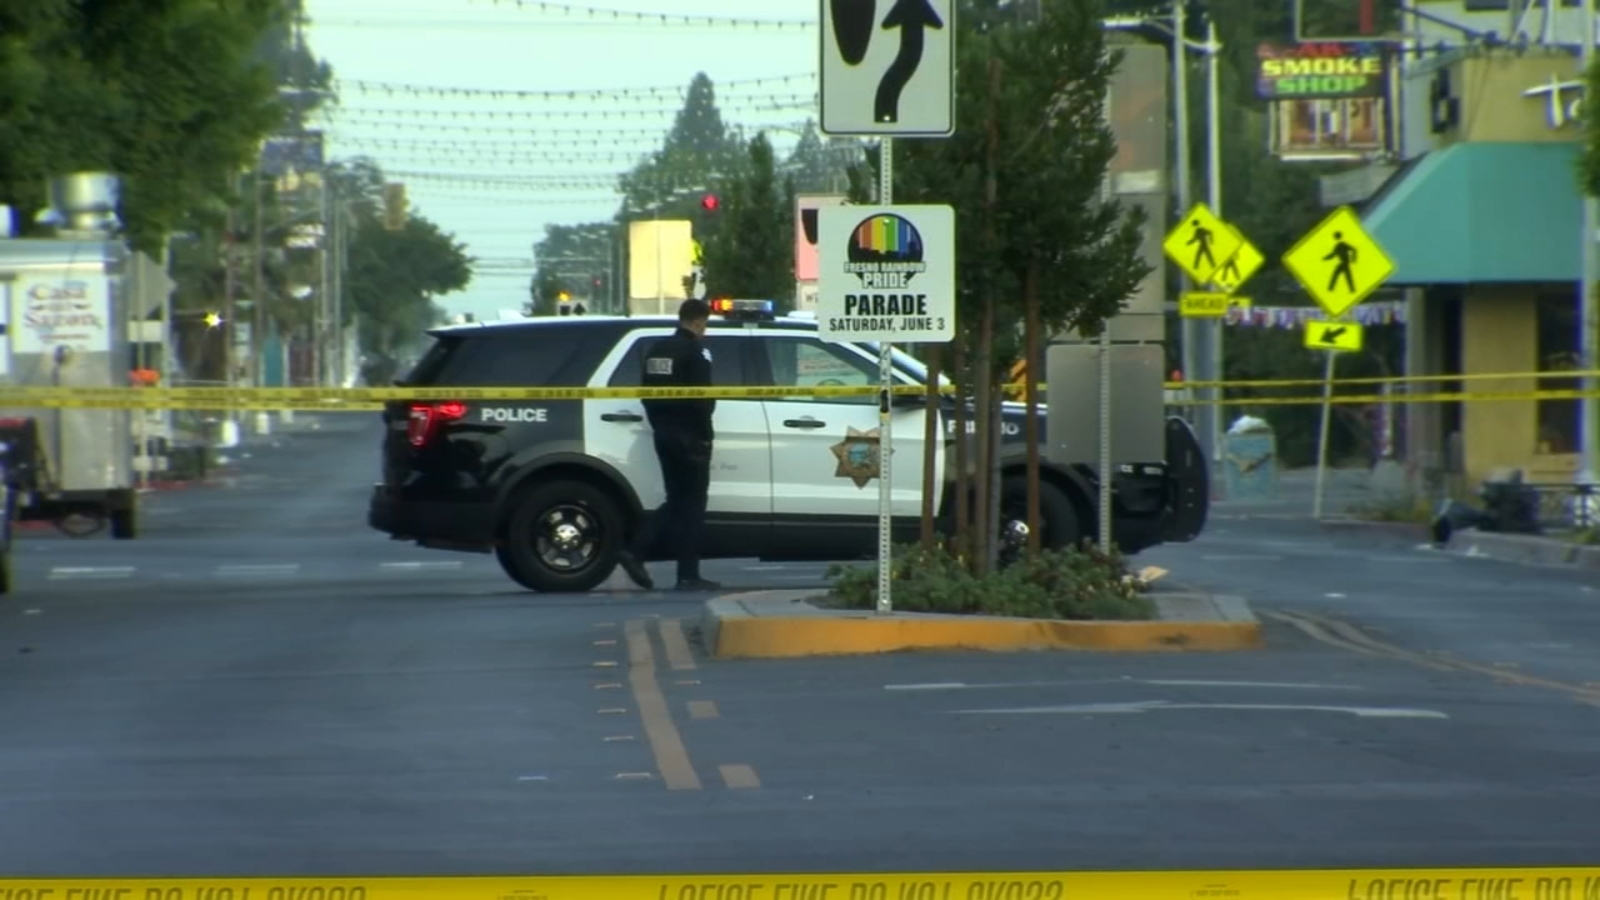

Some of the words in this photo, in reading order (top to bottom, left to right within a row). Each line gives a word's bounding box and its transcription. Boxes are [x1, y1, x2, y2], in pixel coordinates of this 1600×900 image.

[1262, 56, 1382, 76] SMOKE
[1276, 75, 1368, 95] SHOP
[844, 261, 880, 273] FRESNO
[862, 272, 909, 289] PRIDE
[844, 294, 927, 316] PARADE
[829, 317, 896, 333] SATURDAY,
[900, 317, 933, 331] JUNE
[937, 317, 945, 331] 3
[480, 407, 548, 422] POLICE
